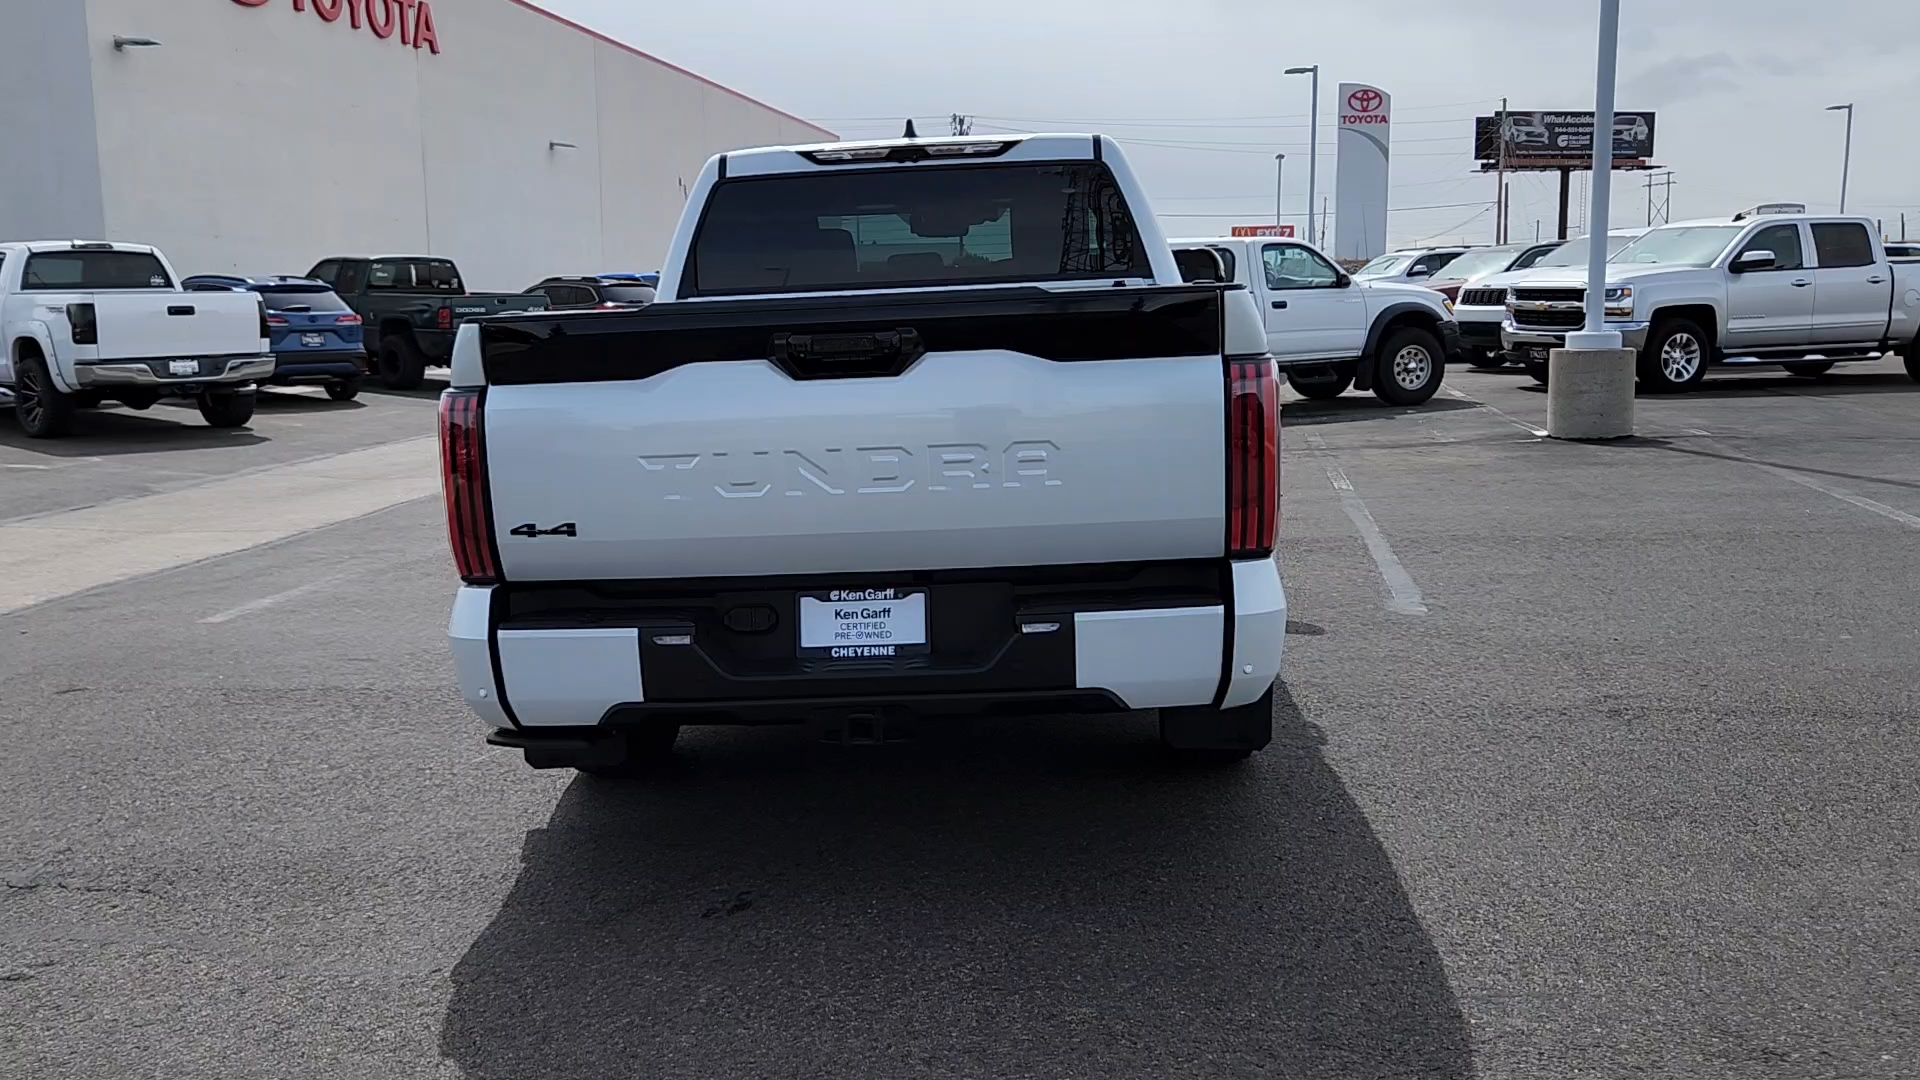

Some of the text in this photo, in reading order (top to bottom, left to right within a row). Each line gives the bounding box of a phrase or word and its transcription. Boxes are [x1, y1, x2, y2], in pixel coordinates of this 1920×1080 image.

[292, 0, 440, 55] OYOTA
[1341, 114, 1388, 124] TOYOTA
[1543, 115, 1595, 124] What Accide
[1257, 228, 1290, 237] EXIT 7
[637, 439, 1062, 501] TUNDRA
[841, 588, 895, 600] Ken Garff
[834, 607, 892, 620] Ken Garff
[840, 621, 886, 631] CERTIFIED
[831, 646, 896, 657] CHEYENNE
